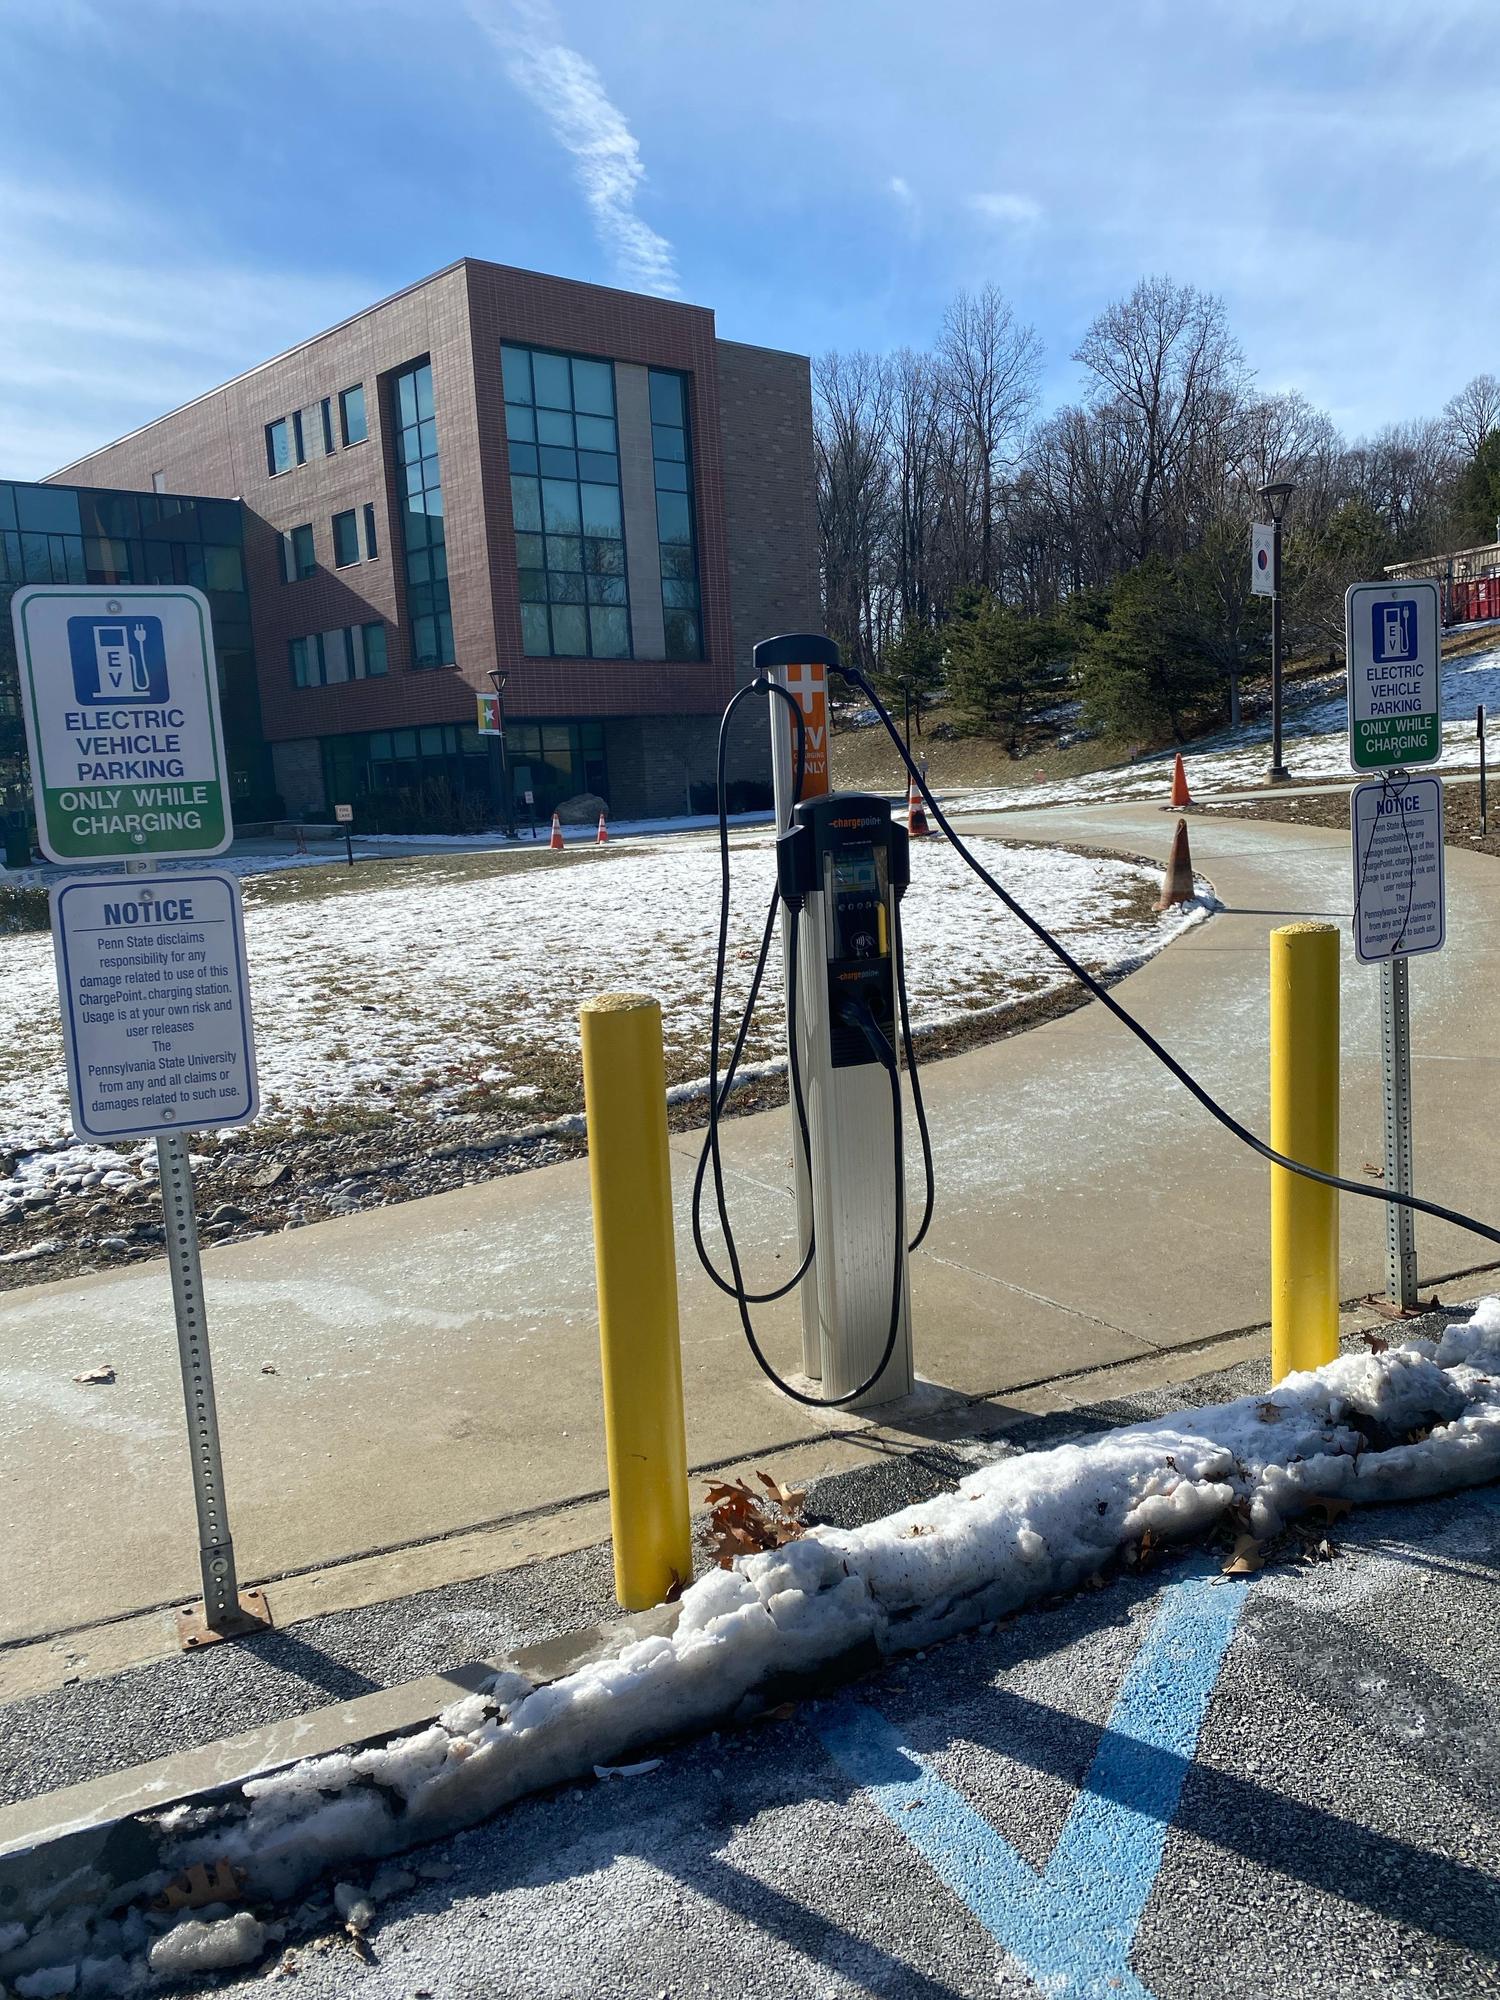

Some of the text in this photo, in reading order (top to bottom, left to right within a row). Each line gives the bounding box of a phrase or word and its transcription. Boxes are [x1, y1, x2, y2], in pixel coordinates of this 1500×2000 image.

[1367, 664, 1424, 681] ELECTRIC
[1371, 682, 1421, 697] VEHICLE
[1371, 699, 1422, 715] PARKING
[65, 709, 185, 731] ELECTRIC
[1361, 717, 1432, 736] ONLY WHILE
[76, 735, 181, 755] VEHICLE
[1366, 734, 1428, 753] CHARGING
[77, 759, 184, 781] PARKING
[59, 786, 208, 811] ONLY WHILE
[1376, 796, 1420, 815] NOTICE
[72, 811, 202, 836] CHARGING
[104, 899, 194, 926] NOTICE
[98, 933, 205, 950] Penn State disclaims
[100, 951, 206, 969] responsibility for any
[80, 965, 228, 988] damage related to use of this
[149, 985, 192, 1000] charging
[195, 983, 232, 996] station.
[82, 999, 232, 1024] Usage is at your own risk and
[126, 1021, 194, 1038] user releases
[152, 1040, 171, 1052] The
[88, 1051, 236, 1077] Pennsylvania State University
[99, 1070, 230, 1094] from any and all claims or
[92, 1086, 240, 1112] damages related to such use.
